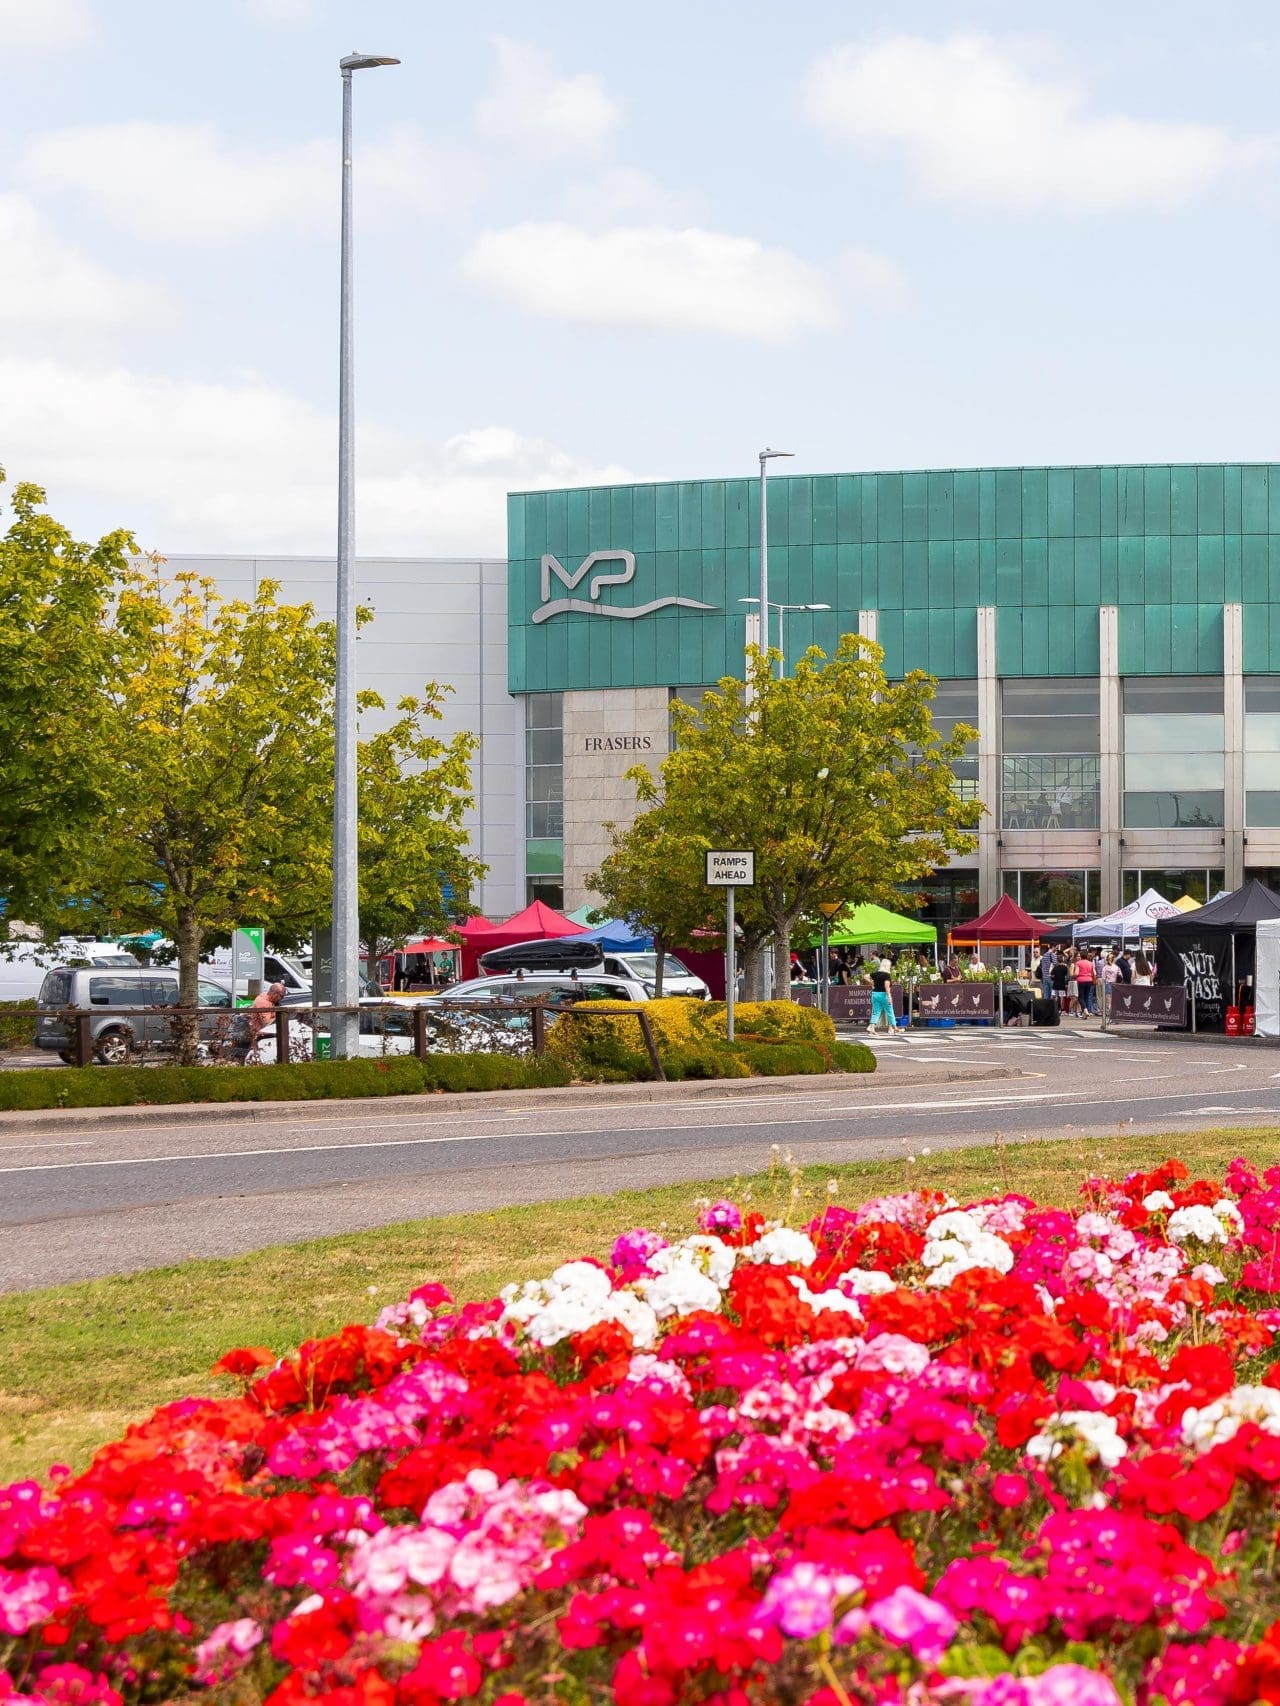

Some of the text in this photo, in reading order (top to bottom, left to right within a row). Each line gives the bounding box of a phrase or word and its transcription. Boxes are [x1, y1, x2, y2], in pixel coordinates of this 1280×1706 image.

[585, 736, 651, 751] FRASERS
[713, 857, 748, 866] RAMPS
[714, 870, 747, 879] AHEAD
[1179, 951, 1216, 977] NUT
[1184, 976, 1223, 1000] CASE
